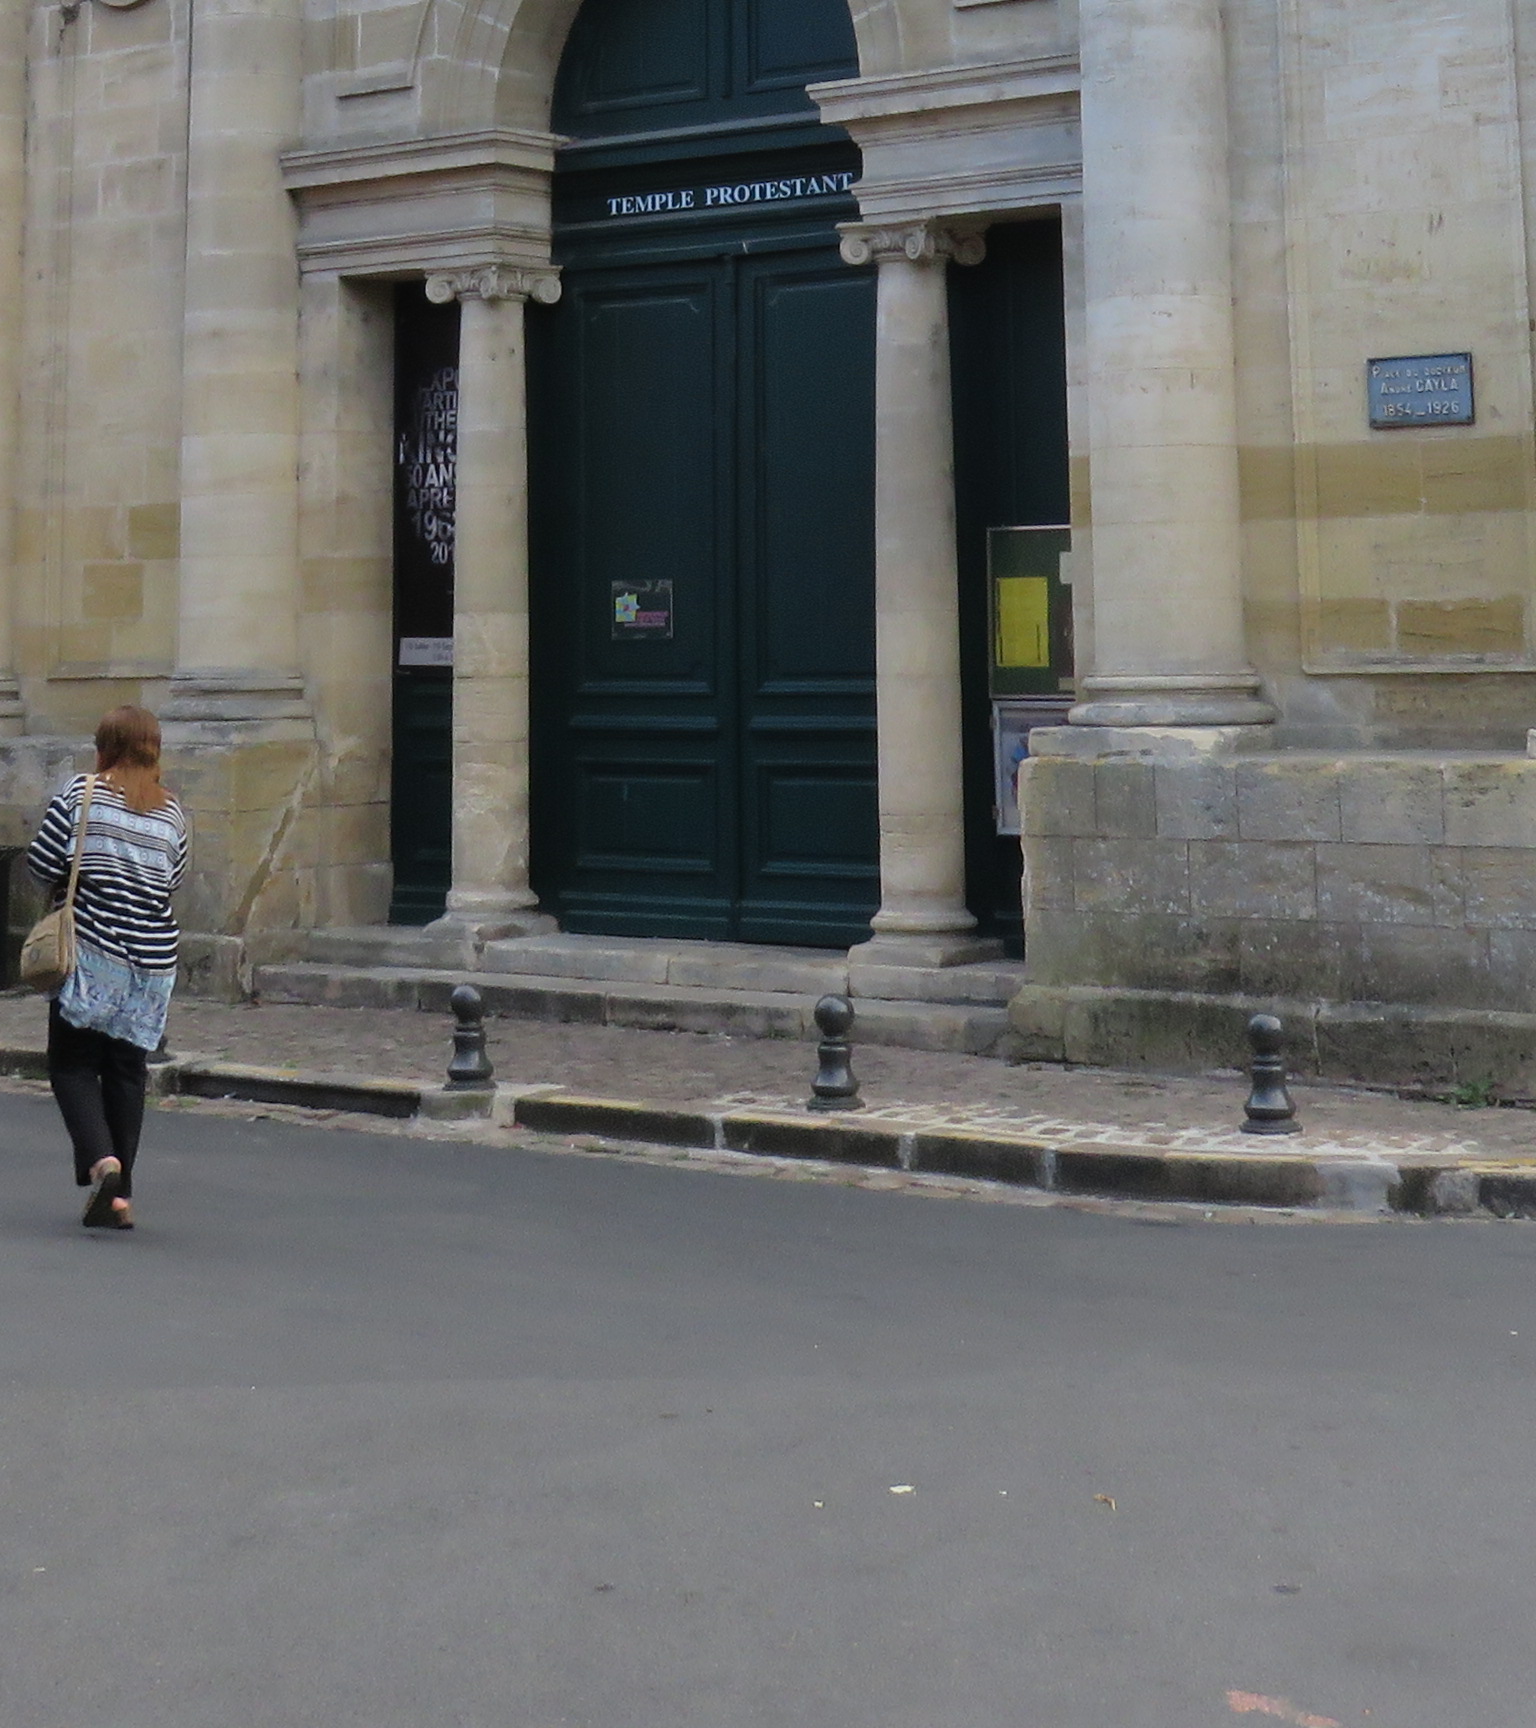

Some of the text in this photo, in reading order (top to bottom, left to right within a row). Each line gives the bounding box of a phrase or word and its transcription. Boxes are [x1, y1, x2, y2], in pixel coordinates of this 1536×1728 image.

[607, 172, 853, 215] TEMPLE PROTESTANT
[1415, 378, 1459, 393] CAYLA
[425, 462, 456, 487] AN
[407, 488, 455, 509] APRE
